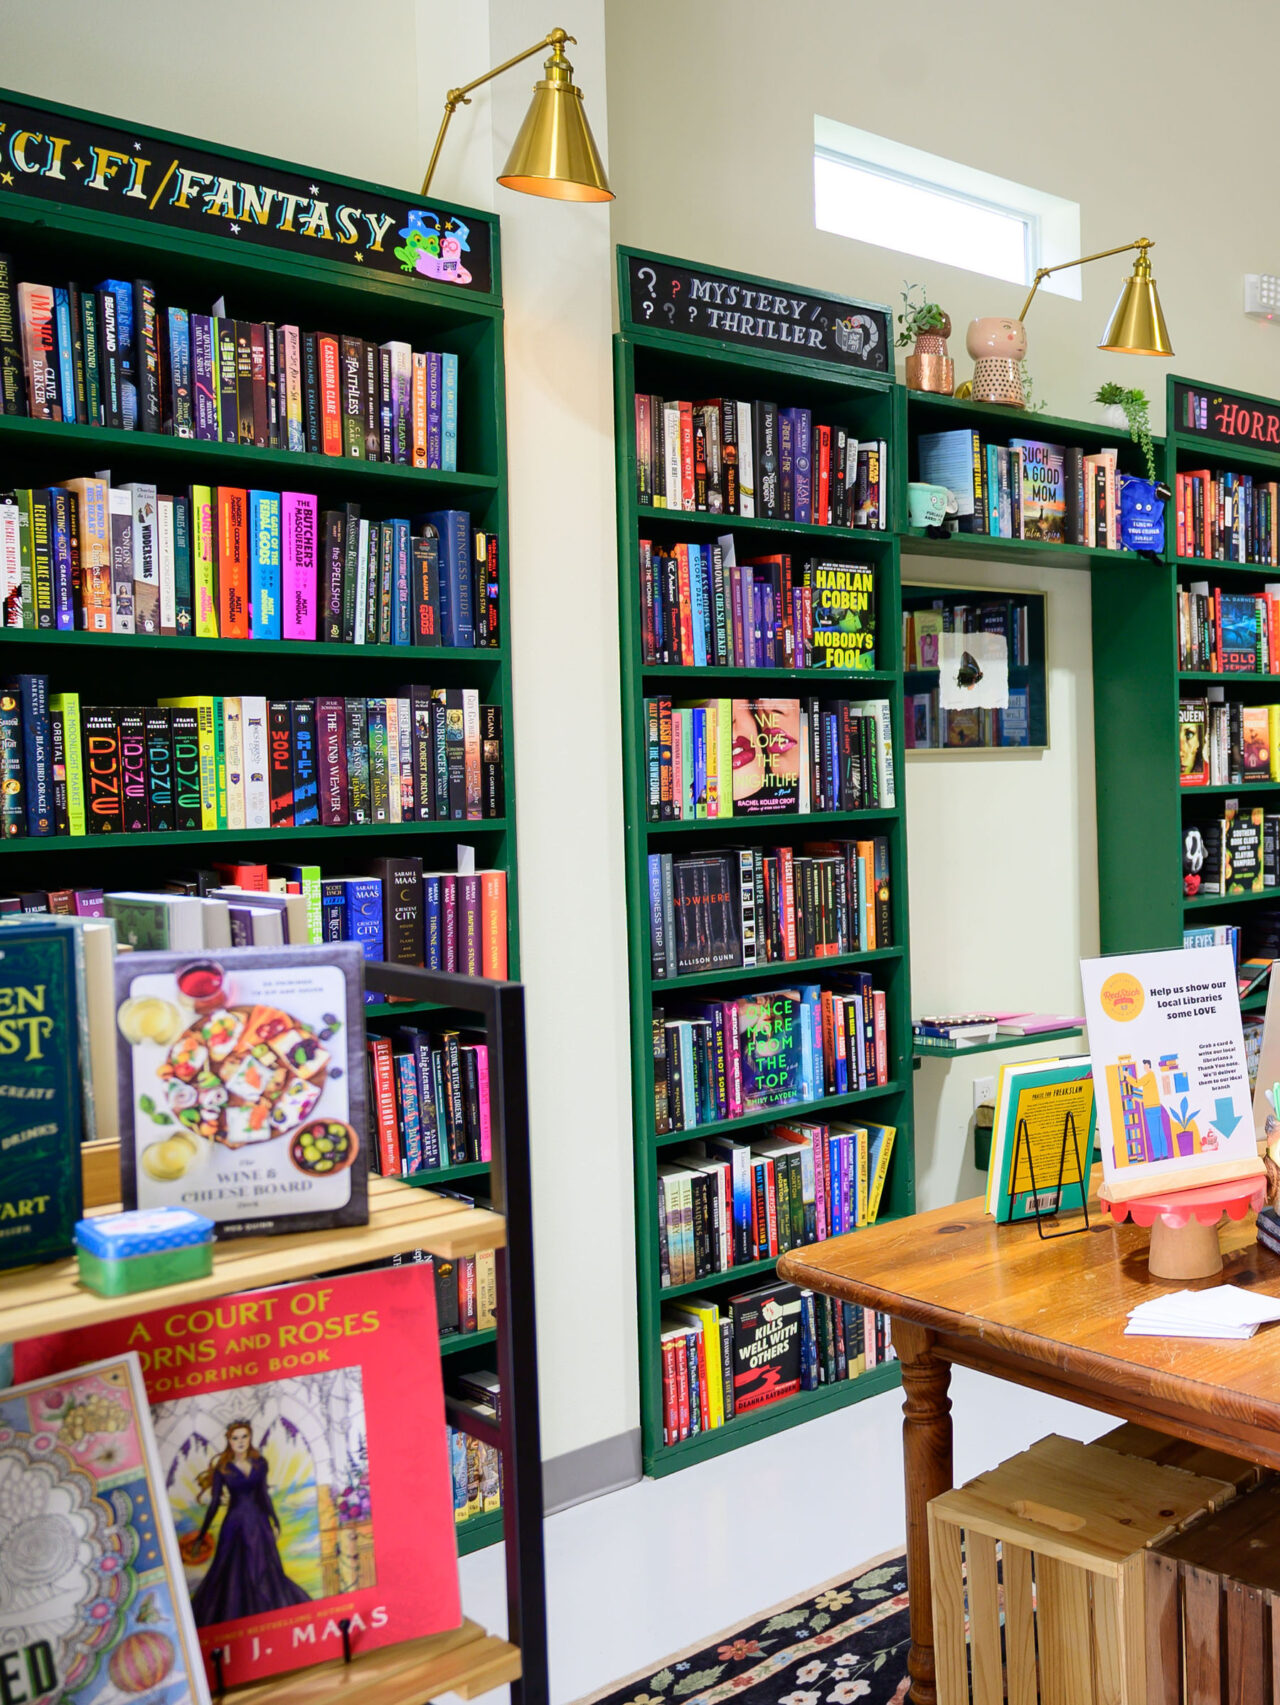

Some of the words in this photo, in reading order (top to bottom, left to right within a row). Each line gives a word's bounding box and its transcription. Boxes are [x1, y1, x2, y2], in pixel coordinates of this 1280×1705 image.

[31, 293, 54, 351] IMAJICA
[104, 296, 116, 352] BEAUTYLAND
[707, 308, 826, 350] THRILLER
[324, 345, 335, 388] CASSANDRA
[32, 360, 46, 404] BARKER
[45, 367, 57, 400] CLIVE
[326, 391, 337, 415] CLARE
[1023, 446, 1049, 463] SUCH
[1032, 467, 1060, 485] GOOD
[296, 500, 311, 508] THE
[1032, 485, 1057, 503] MOM
[294, 507, 304, 567] MASQUERADE
[303, 509, 313, 568] BUTCHER'S
[142, 525, 153, 579] WIDDERSHINS
[457, 525, 469, 581] PRINCESS
[816, 570, 873, 592] HARLAN
[459, 585, 469, 617] BRIDE
[822, 590, 868, 611] COBEN
[814, 631, 874, 649] NOBODY'S
[826, 649, 863, 669] FOOL
[1222, 653, 1256, 664] COLD
[328, 712, 337, 732] THE
[487, 709, 495, 738] TIGANA
[755, 712, 780, 728] WE
[1179, 711, 1204, 723] QUEEN
[53, 722, 63, 762] ORBITAL
[272, 731, 289, 770] WOOL
[750, 734, 786, 748] LOVE
[296, 731, 312, 779] SHIFT
[756, 753, 781, 768] THE
[89, 737, 119, 815] DUNE
[124, 744, 145, 798] DUNE
[150, 748, 171, 804] DUNE
[176, 744, 200, 808] DUNE
[329, 764, 340, 812] WEAVER
[737, 799, 758, 807] RACHEL
[395, 877, 417, 885] MAAS
[674, 892, 731, 907] NOWHERE
[395, 912, 417, 921] CITY
[679, 956, 710, 966] ALLISON
[712, 953, 734, 963] GUNN
[1150, 988, 1171, 996] Help
[1186, 983, 1210, 992] show
[746, 1000, 793, 1020] ONCE
[1158, 998, 1181, 1008] Local
[1183, 994, 1222, 1005] Libraries
[1167, 1010, 1192, 1019] some
[1194, 1006, 1216, 1016] LOVE
[747, 1018, 793, 1037] MORE
[748, 1036, 793, 1056] FROM
[756, 1054, 787, 1071] THE
[756, 1073, 788, 1089] TOP
[770, 1090, 797, 1102] LAYDEN
[218, 1170, 260, 1183] WINE
[181, 1185, 251, 1203] CHEESE
[254, 1181, 313, 1195] BOARD
[128, 1321, 152, 1344] A
[165, 1299, 279, 1339] COURT
[290, 1289, 334, 1316] OF
[755, 1317, 783, 1341] KILLS
[138, 1339, 217, 1373] ORNS
[225, 1332, 271, 1356] AND
[279, 1311, 381, 1348] ROSES
[739, 1341, 769, 1360] WELL
[770, 1322, 798, 1345] WITH
[270, 1349, 331, 1372] BOOK
[750, 1340, 790, 1369] OTHERS
[739, 1395, 764, 1410] DEANNA
